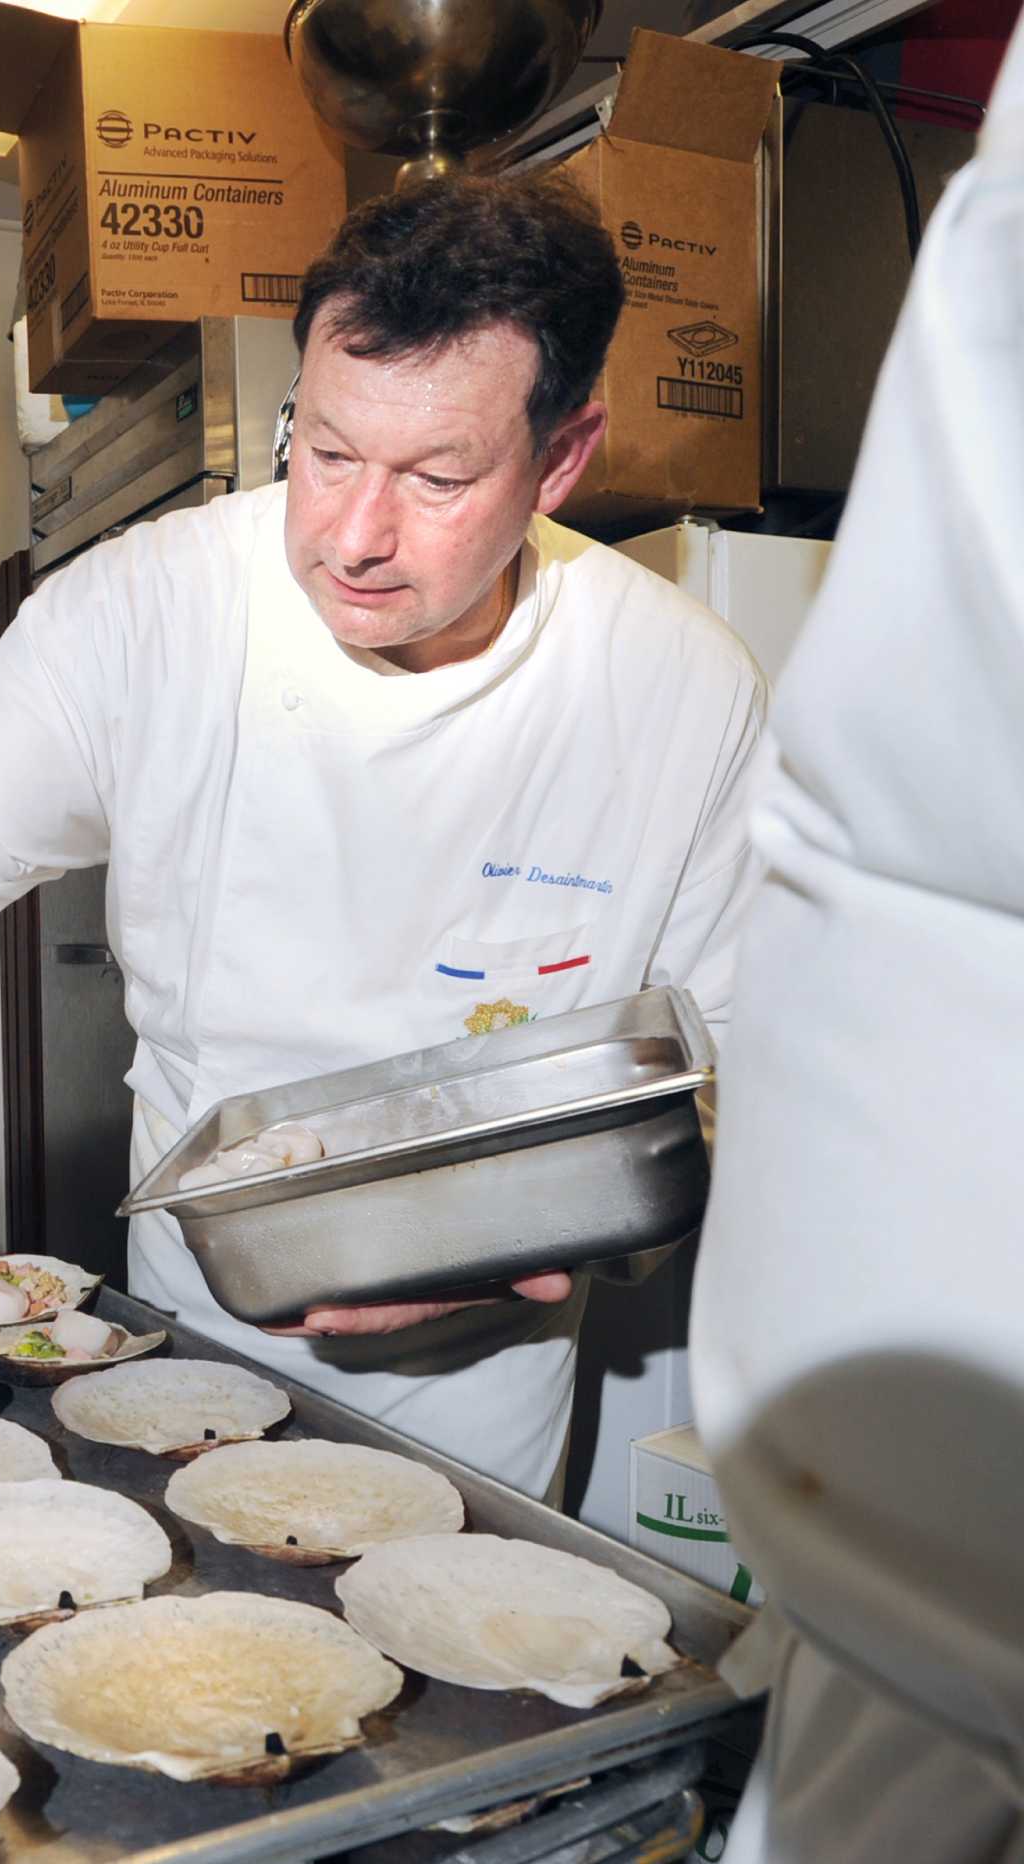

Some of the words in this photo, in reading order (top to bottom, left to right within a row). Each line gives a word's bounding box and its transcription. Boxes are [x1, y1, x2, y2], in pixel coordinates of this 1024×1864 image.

[144, 123, 257, 144] PACTIV
[143, 146, 188, 159] Advanced
[190, 148, 236, 163] Packaging
[238, 151, 278, 164] Solutions
[99, 178, 188, 200] Aluminum
[193, 183, 285, 206] Containers
[100, 202, 205, 239] 42330
[123, 241, 149, 253] Utility
[151, 242, 170, 253] Cup
[171, 243, 189, 252] Full
[649, 233, 717, 255] PACTIV
[622, 256, 676, 277] Aluminum
[623, 272, 679, 292] Containers
[128, 290, 179, 299] Corporation
[678, 357, 743, 384] Y112045
